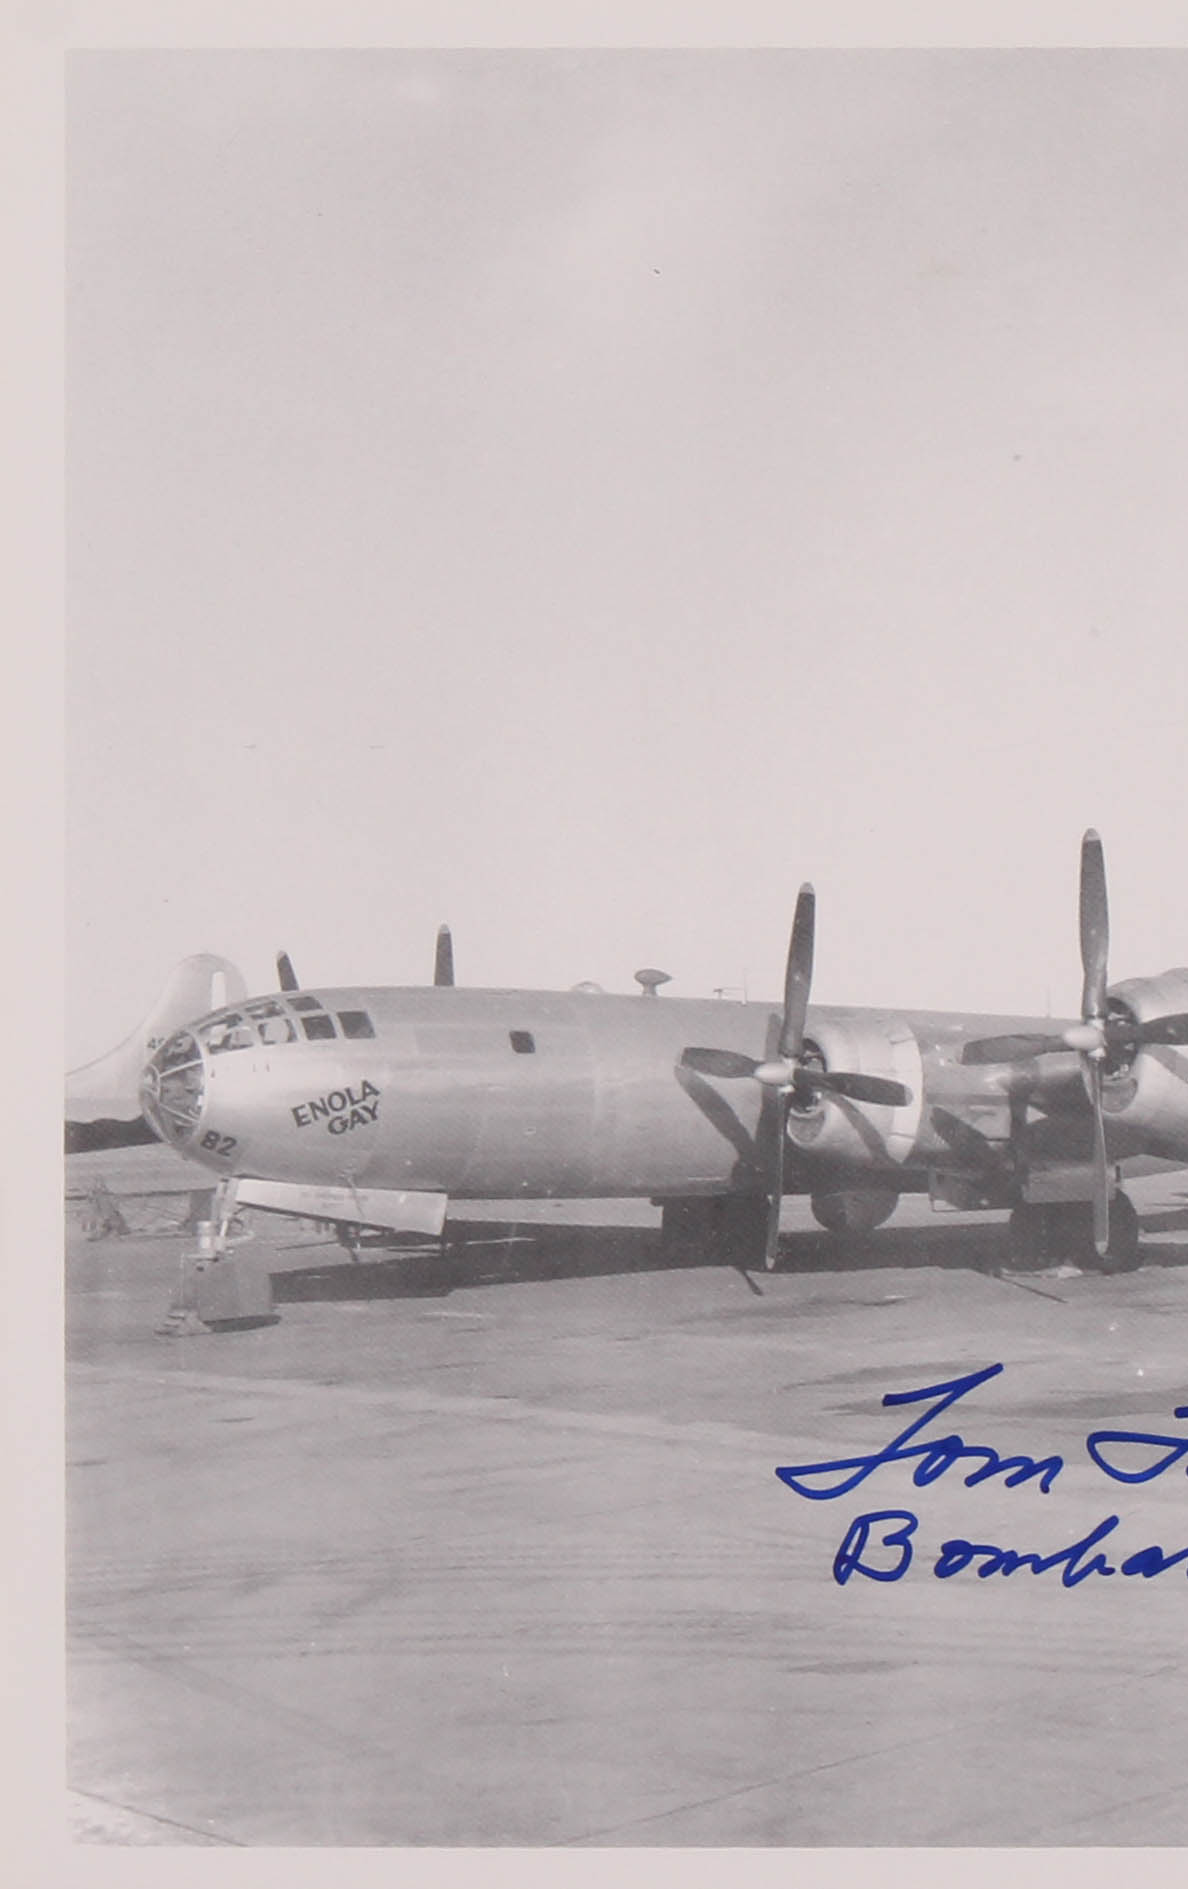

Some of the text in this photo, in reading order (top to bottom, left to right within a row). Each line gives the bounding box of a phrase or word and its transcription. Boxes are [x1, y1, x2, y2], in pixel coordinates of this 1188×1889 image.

[291, 1080, 380, 1128] ENOLA
[327, 1100, 379, 1135] GAY
[776, 1364, 1064, 1500] Tom
